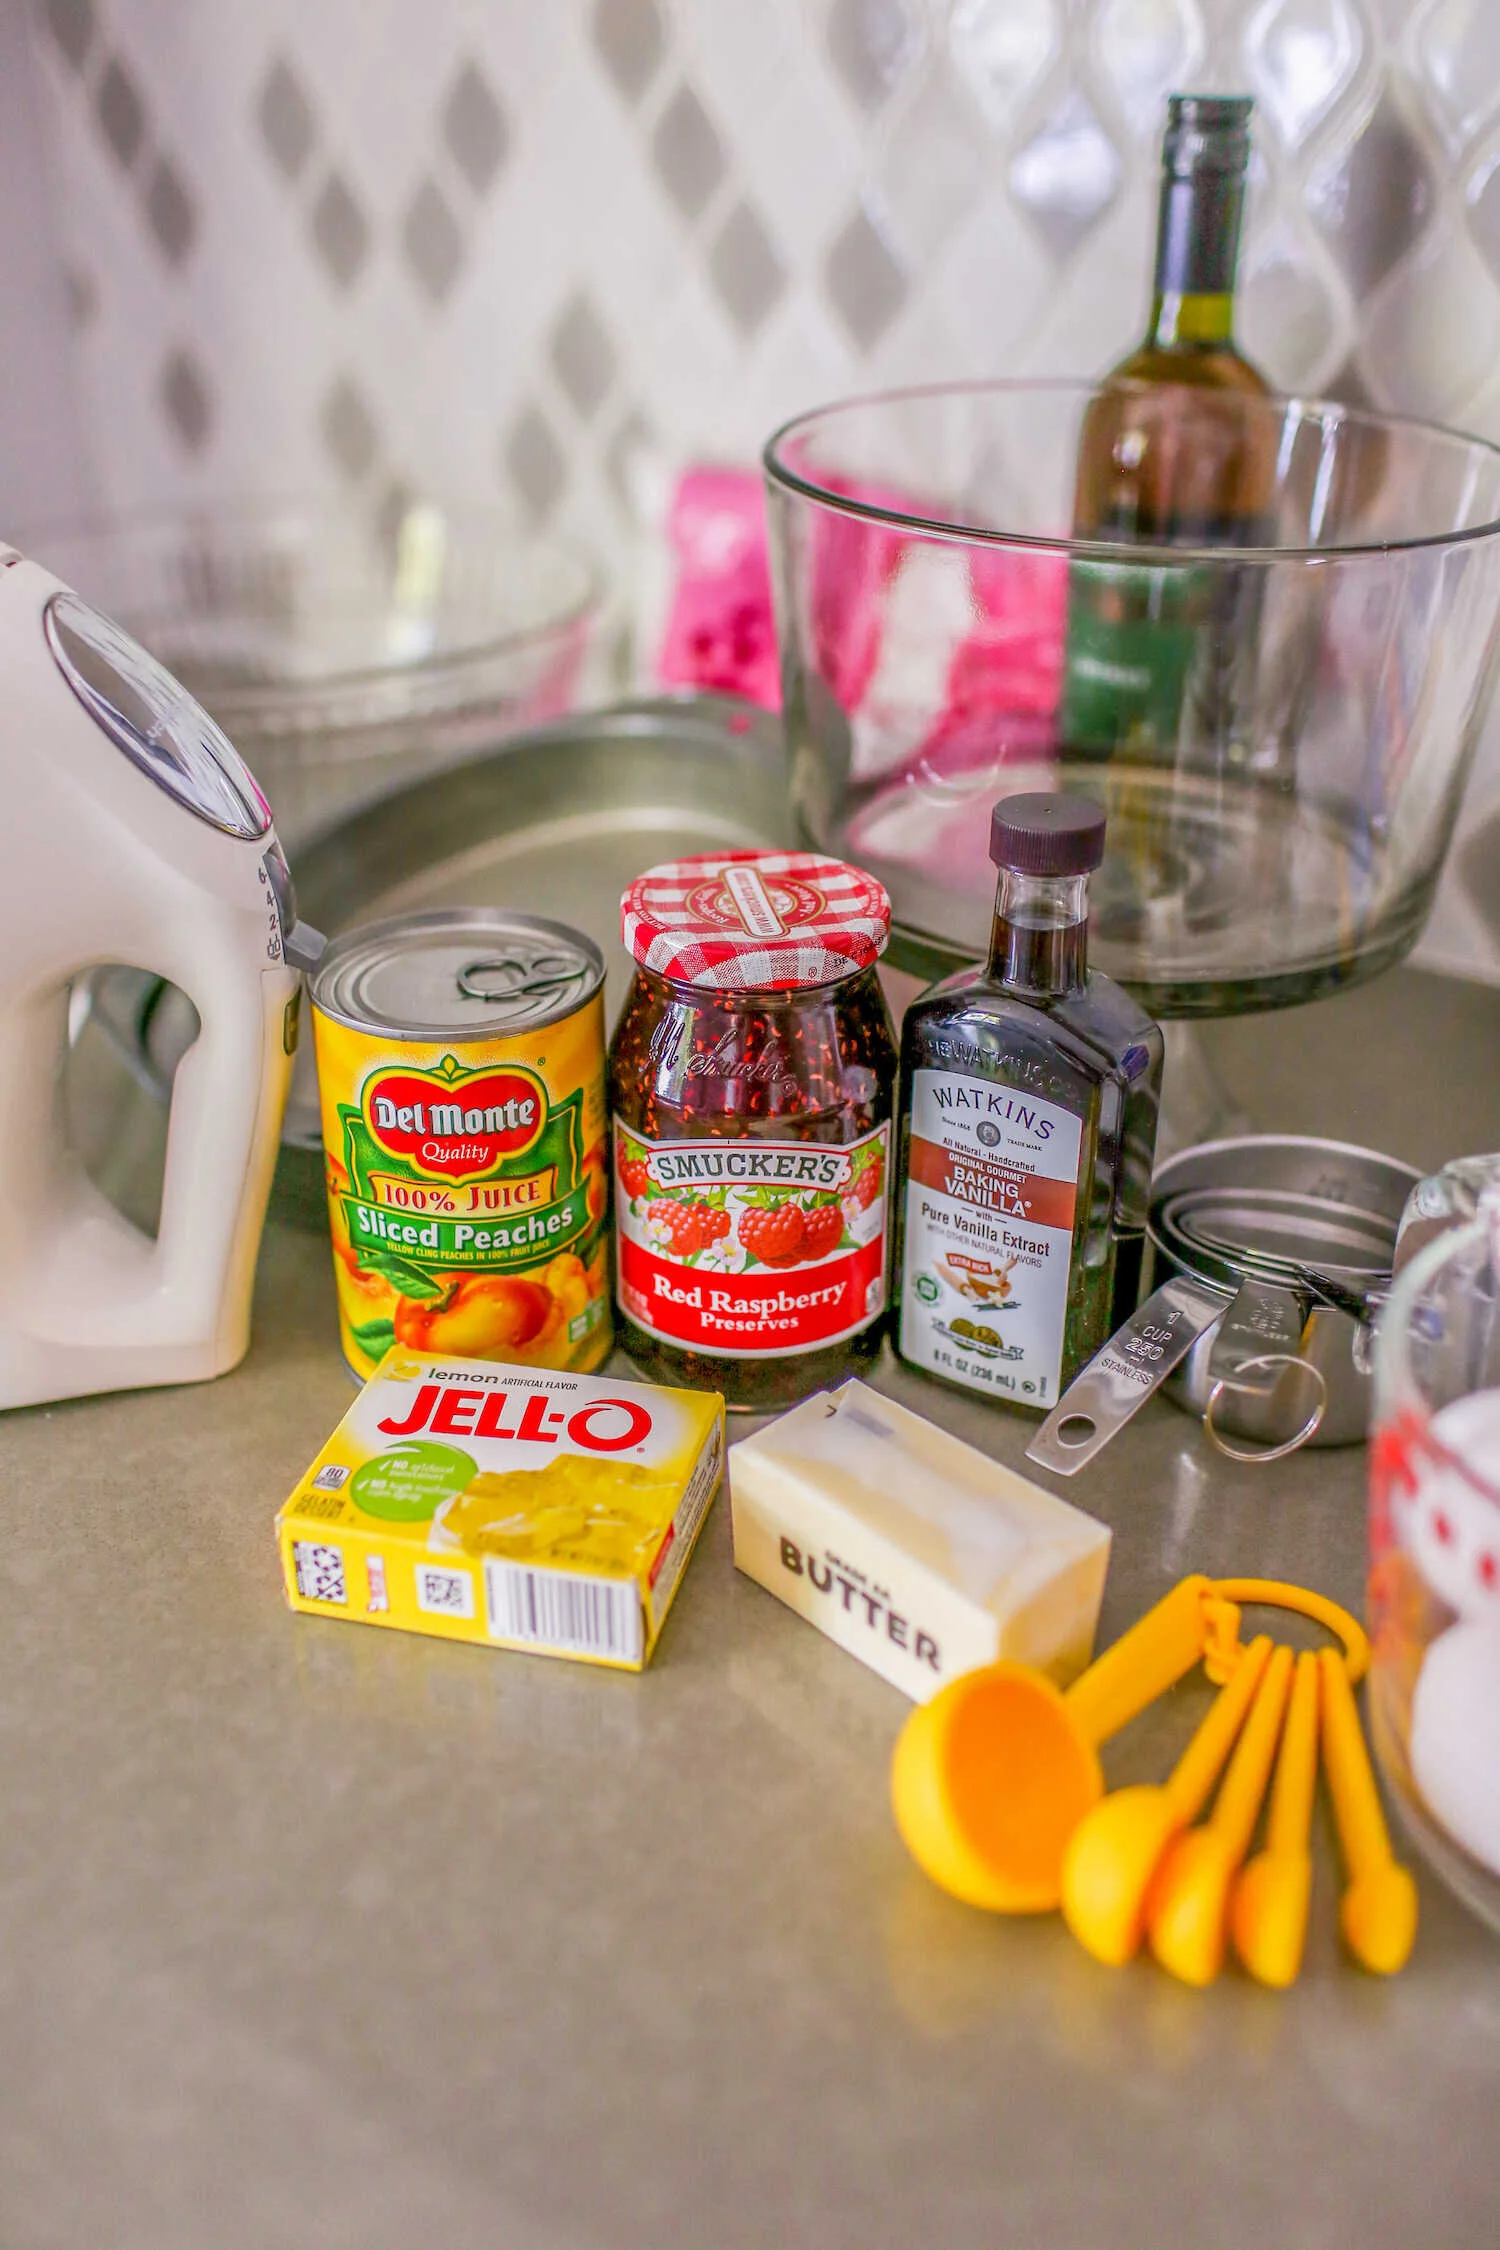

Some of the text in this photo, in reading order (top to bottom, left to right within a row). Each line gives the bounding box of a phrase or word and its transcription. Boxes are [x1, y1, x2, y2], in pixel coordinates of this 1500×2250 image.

[375, 1096, 536, 1136] Del Monte
[932, 1087, 1056, 1140] WATKINS
[422, 1142, 489, 1163] Quality
[656, 1153, 841, 1184] SMUCKER'S
[943, 1136, 1036, 1173] All Natural Handcrafted
[948, 1152, 1027, 1184] ORIGINAL GOURMET
[385, 1180, 540, 1212] 100% JUICE
[953, 1166, 1019, 1199] BAKING
[358, 1207, 573, 1250] Sliced Peaches
[921, 1202, 1051, 1257] Pure Vanilla Extract
[975, 1210, 994, 1223] with
[386, 1242, 413, 1255] YELLOW
[416, 1248, 438, 1259] CLING
[440, 1250, 473, 1260] PEACHES
[476, 1251, 484, 1260] IN
[510, 1245, 531, 1257] FRUIT
[947, 1230, 970, 1245] OTHER
[971, 1239, 1005, 1258] NATURAL
[1007, 1250, 1042, 1269] FLAVORS
[949, 1255, 989, 1274] EXTRA RICH
[652, 1273, 702, 1308] Red
[709, 1281, 847, 1319] Raspberry
[700, 1311, 799, 1332] Preserves
[1143, 1325, 1173, 1343] CUP
[1124, 1337, 1164, 1361] 250
[428, 1367, 578, 1391] lemon ARTIFICIAL FLAVOR
[1101, 1358, 1154, 1385] STAINLESS
[377, 1385, 653, 1452] JELL-O
[780, 1536, 941, 1673] BUTTER
